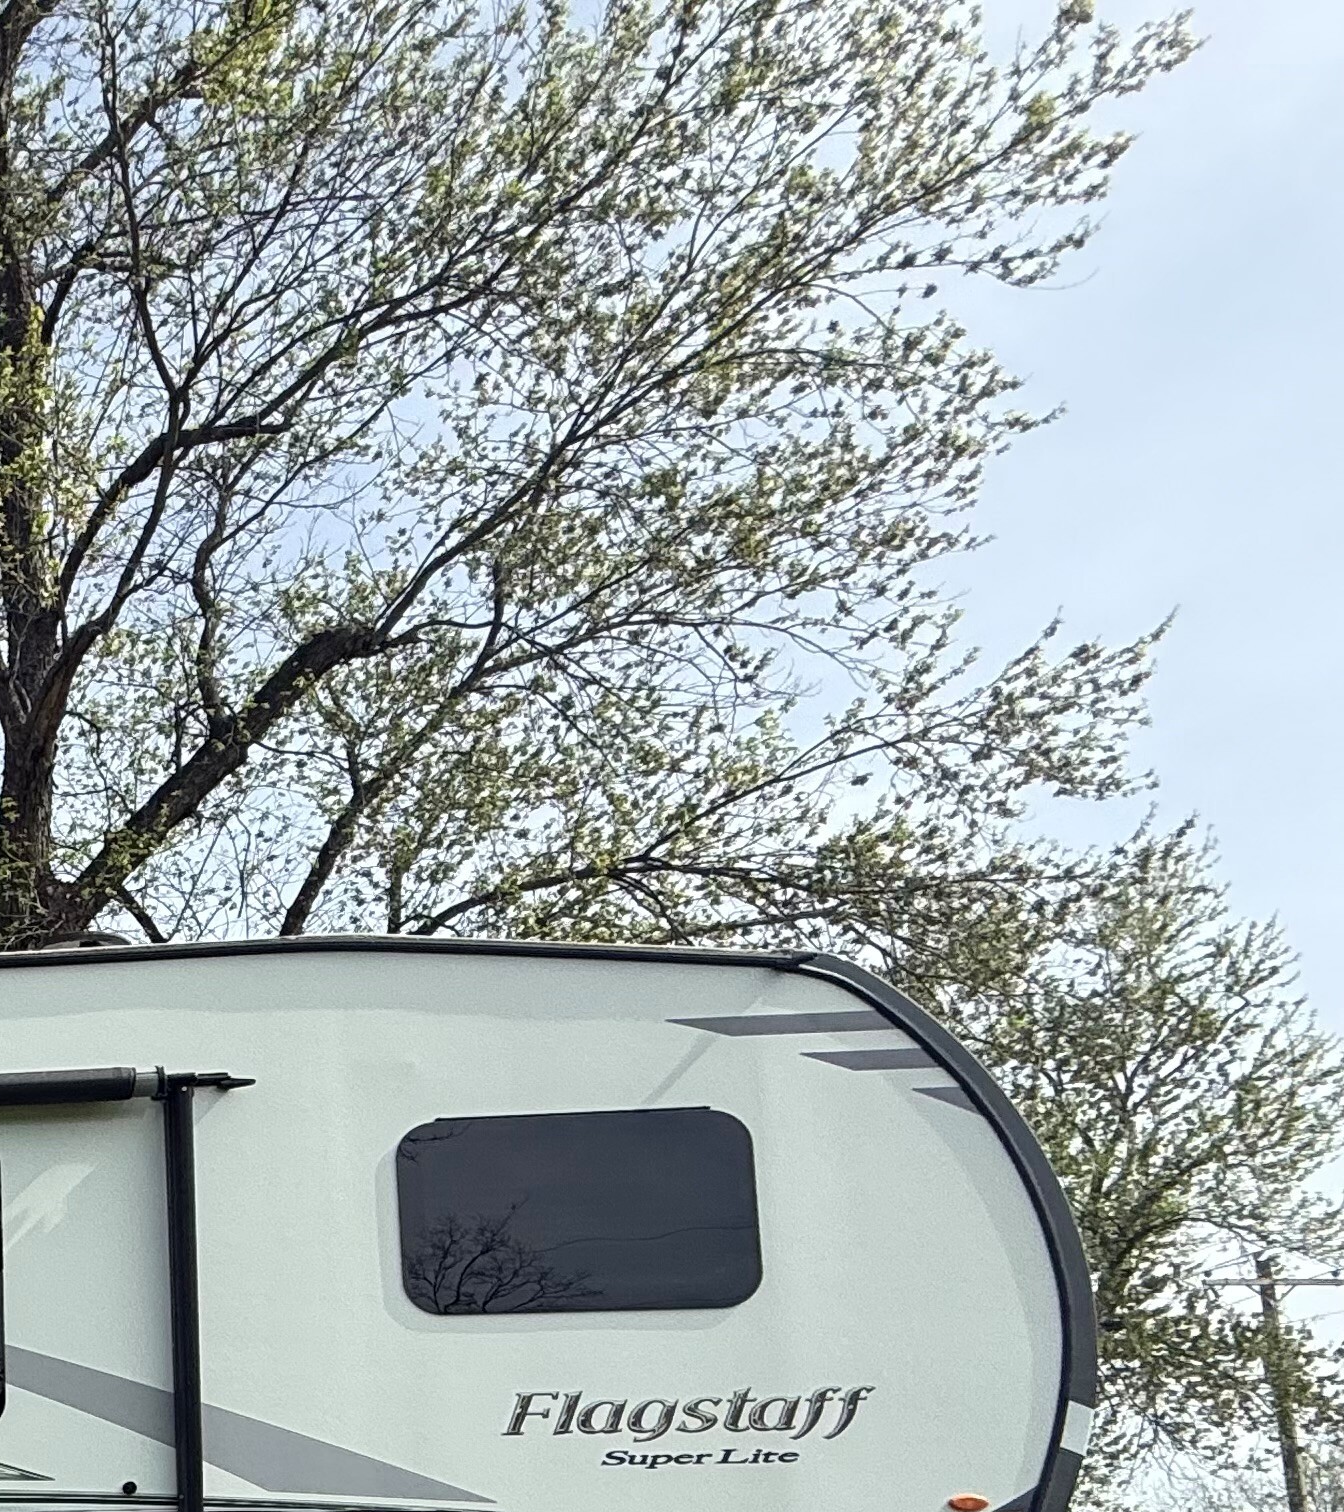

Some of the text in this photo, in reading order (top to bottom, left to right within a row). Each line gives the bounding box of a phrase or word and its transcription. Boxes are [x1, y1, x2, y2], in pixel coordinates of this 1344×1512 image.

[500, 1383, 876, 1443] Flagstaff
[600, 1448, 800, 1470] Super Lite
